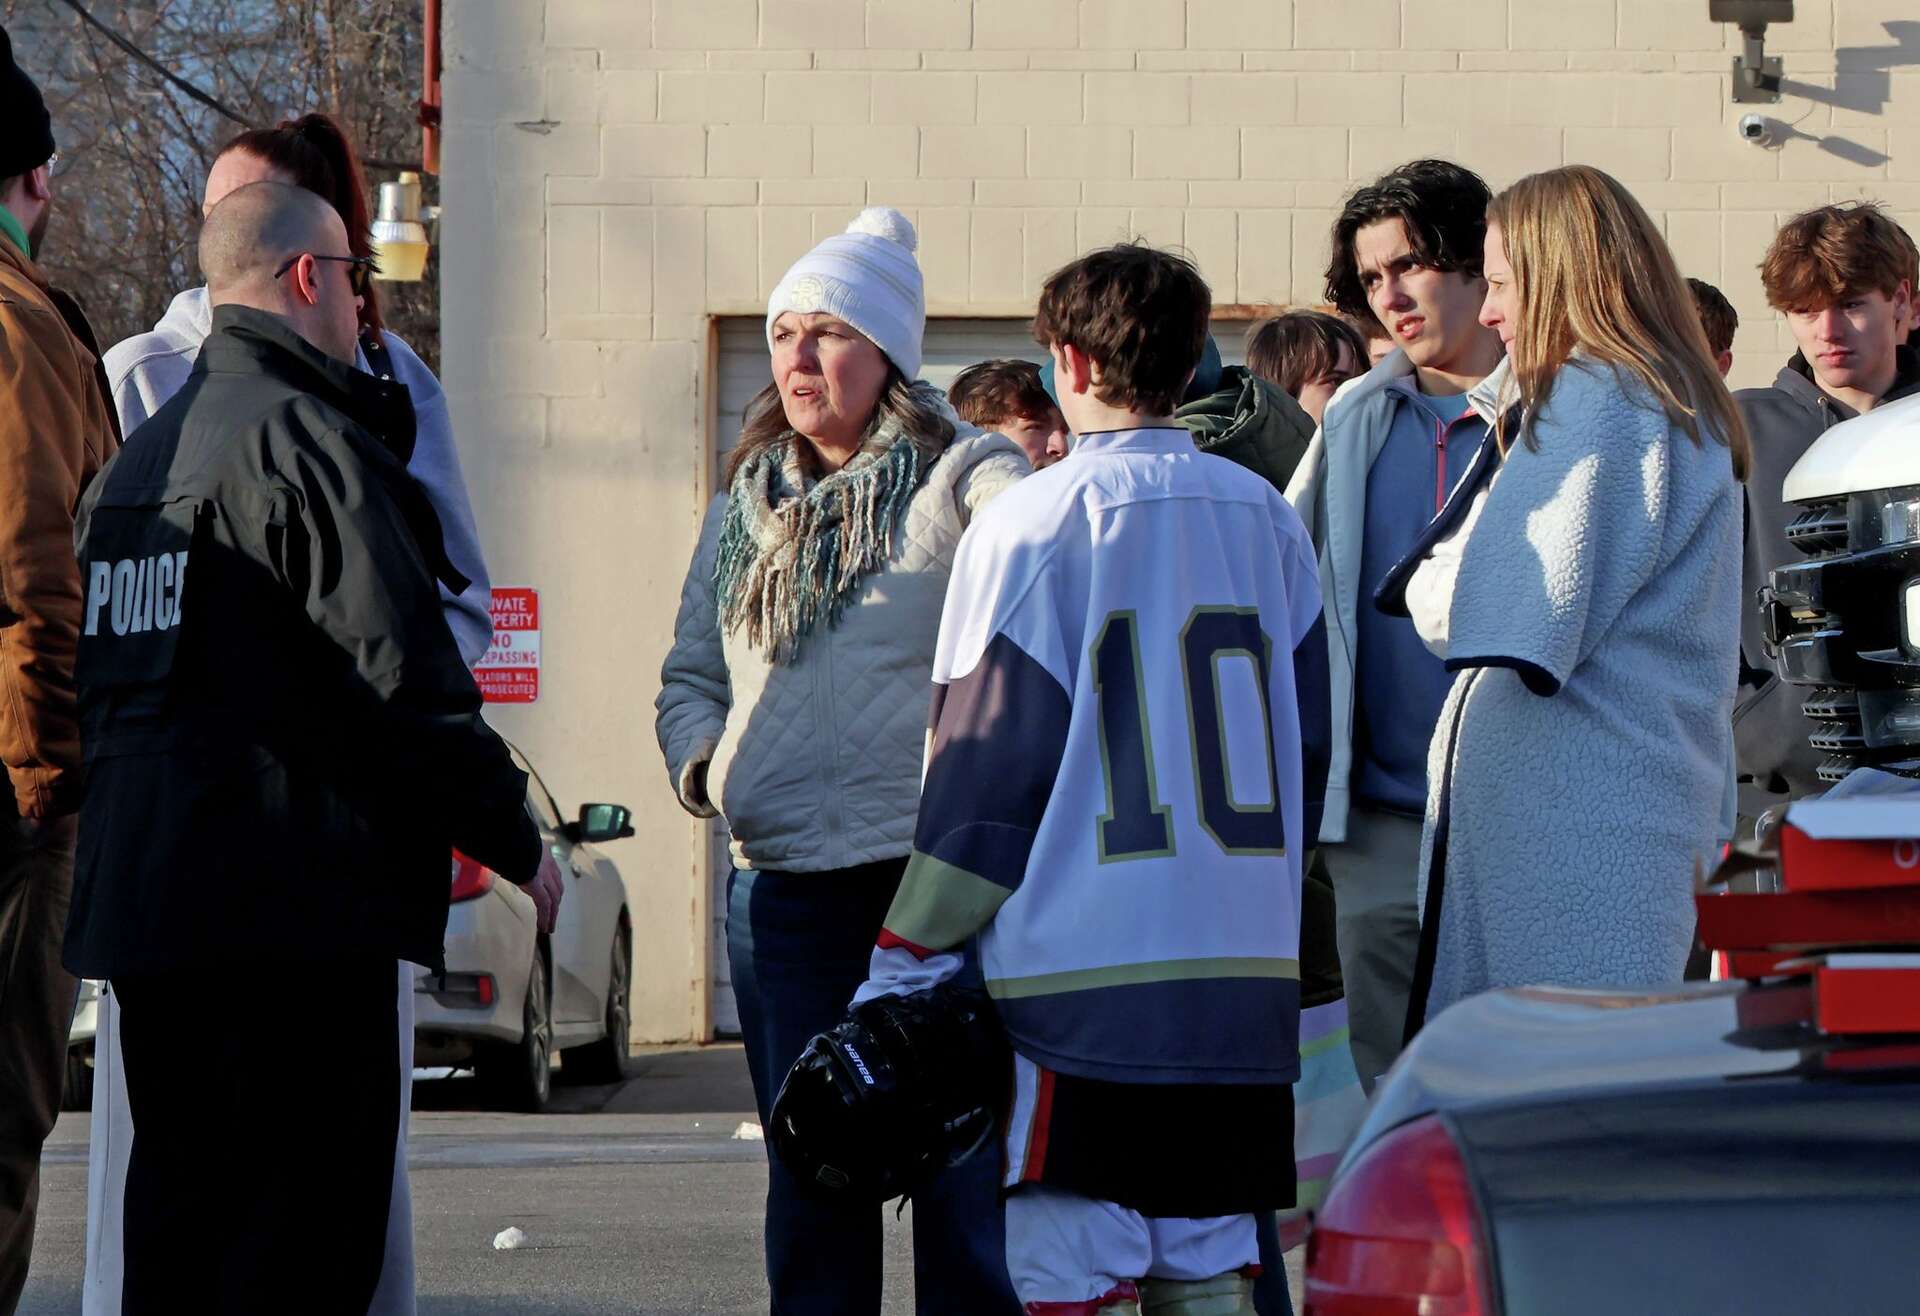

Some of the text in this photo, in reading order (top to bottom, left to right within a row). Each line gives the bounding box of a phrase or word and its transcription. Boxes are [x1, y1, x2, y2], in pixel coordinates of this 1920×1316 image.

[492, 597, 527, 611] IVATE
[493, 613, 534, 627] PERTY
[480, 651, 536, 664] SPASSING
[1089, 604, 1287, 865] 10
[844, 1043, 874, 1084] BAUER
